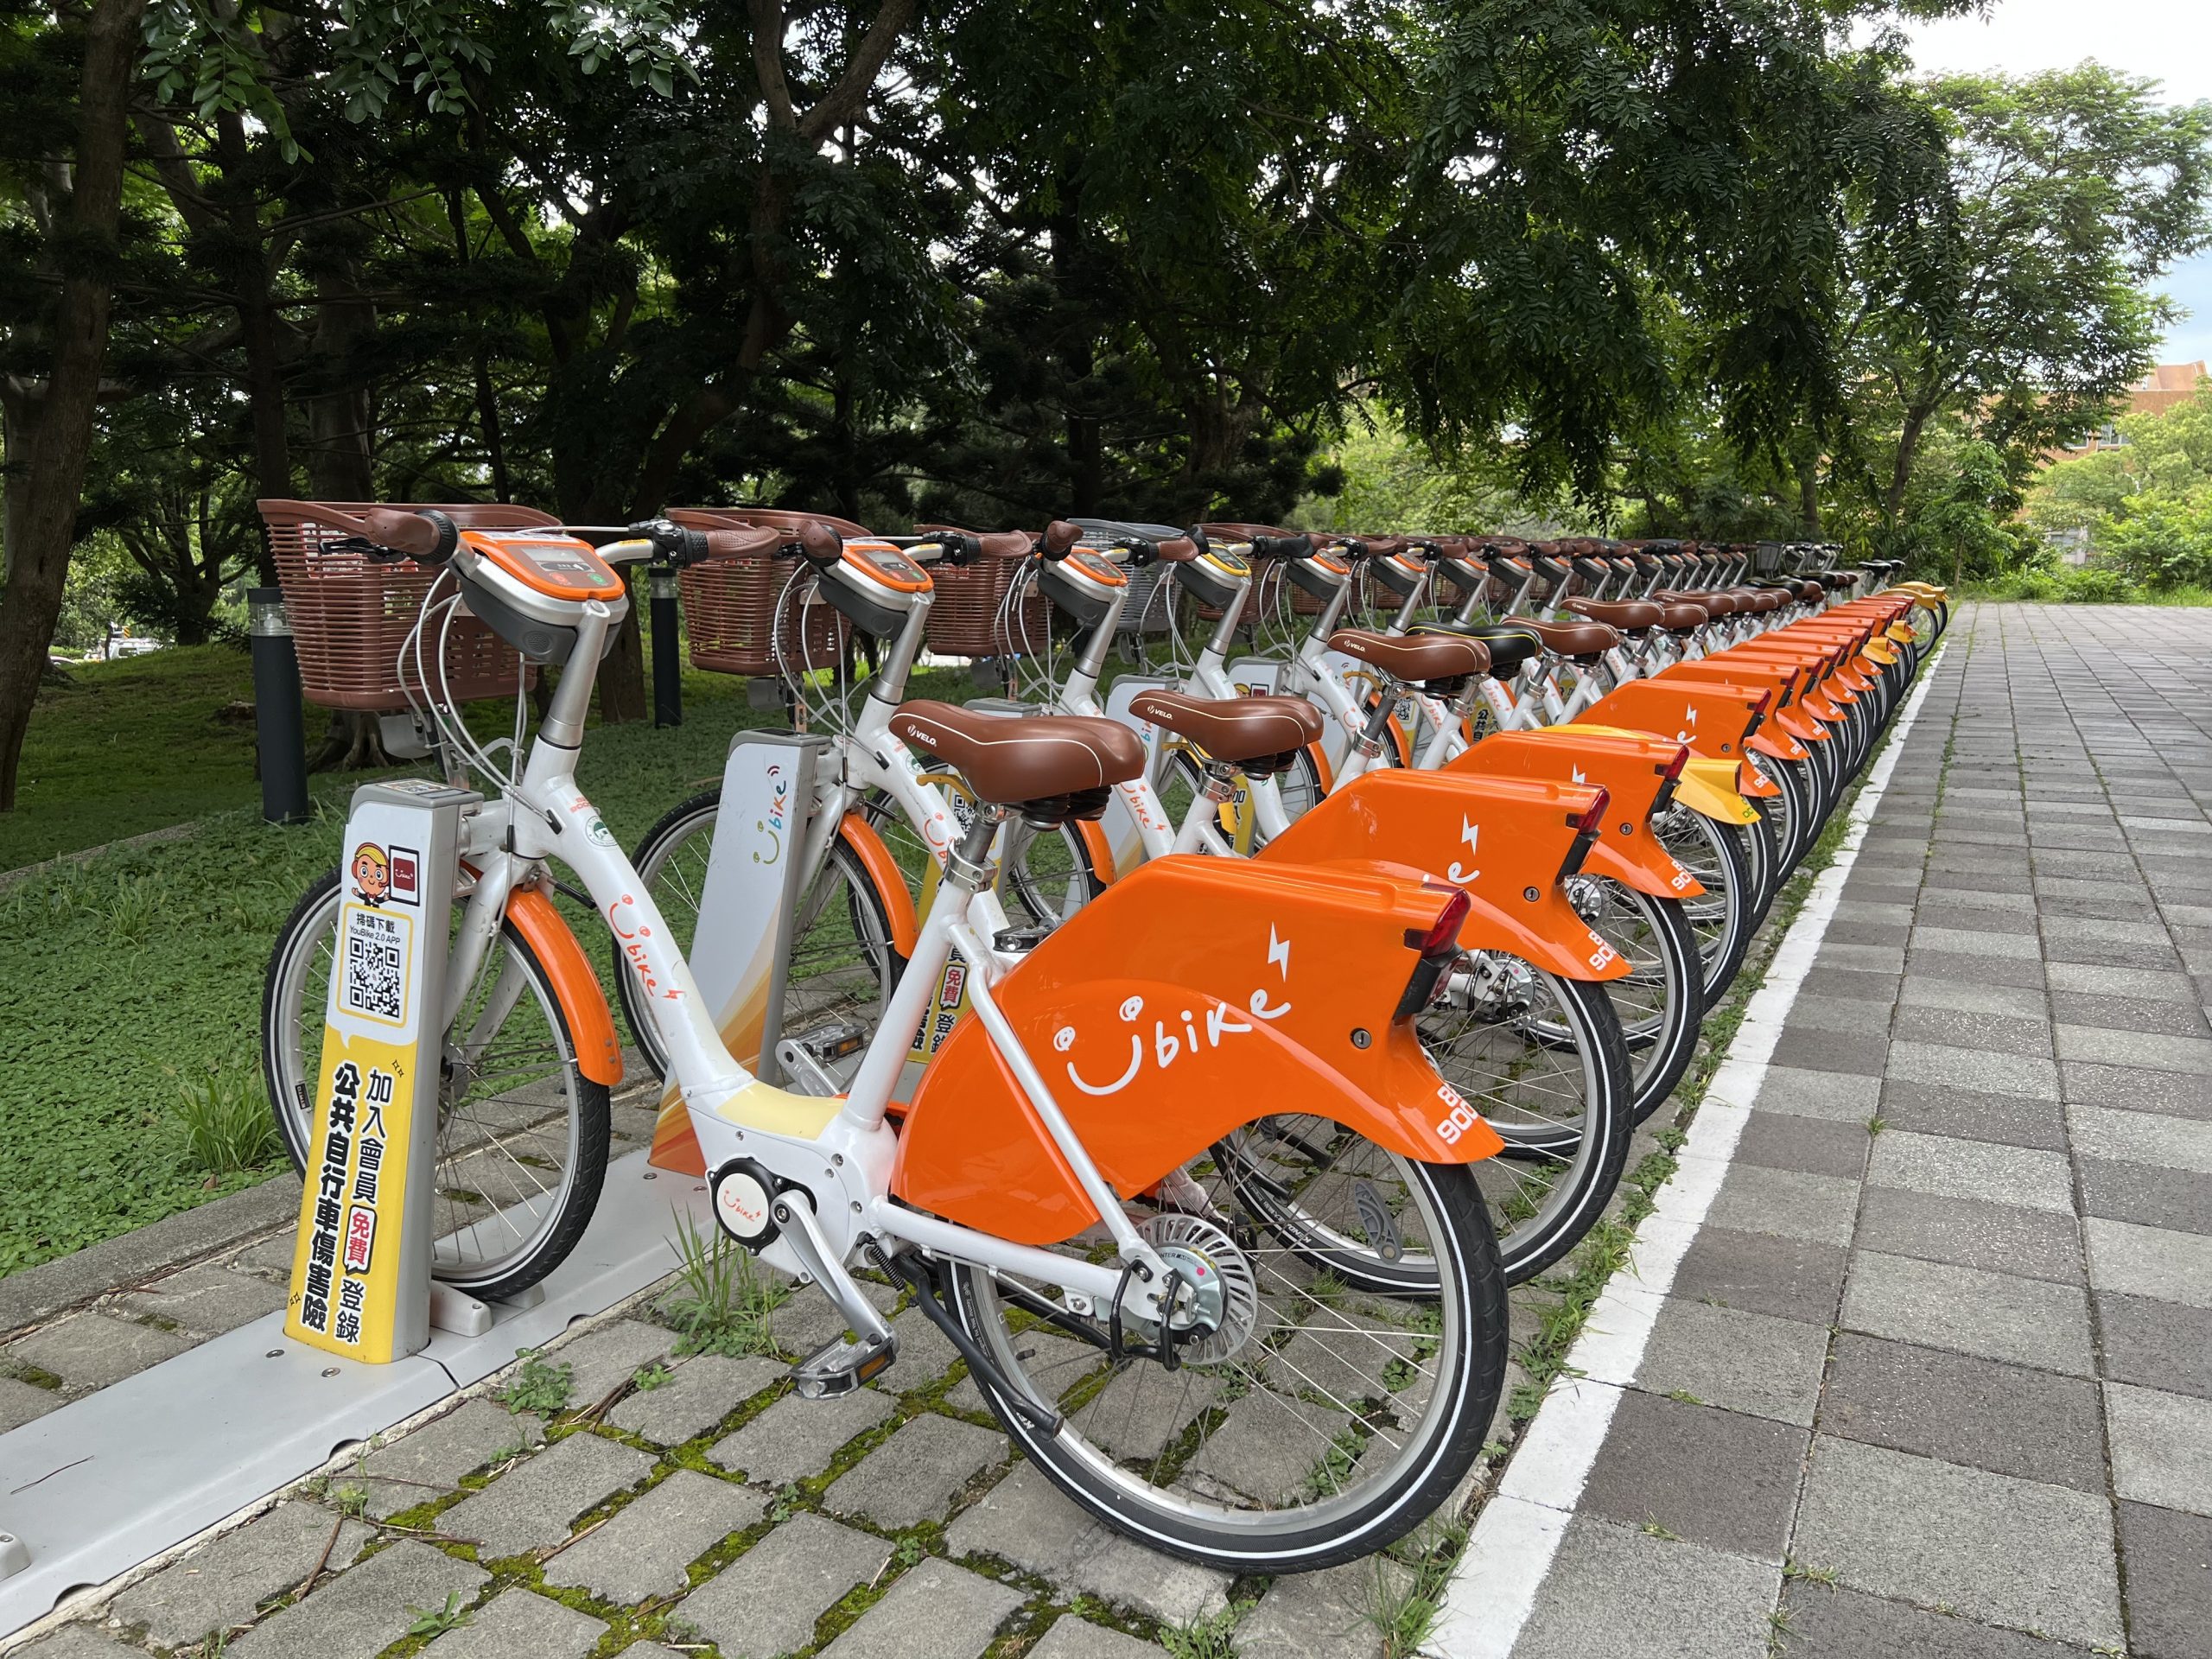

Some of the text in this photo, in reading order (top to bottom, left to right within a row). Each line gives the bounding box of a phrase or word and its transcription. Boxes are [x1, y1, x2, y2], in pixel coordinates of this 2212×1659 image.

[1351, 642, 1366, 652] VELO
[1154, 709, 1173, 720] VELO
[916, 730, 937, 746] VELO
[356, 912, 396, 934] 掃碼下載
[349, 925, 401, 945] YouBike 2.0 APP
[302, 1063, 360, 1332] 公共自行車傷害險
